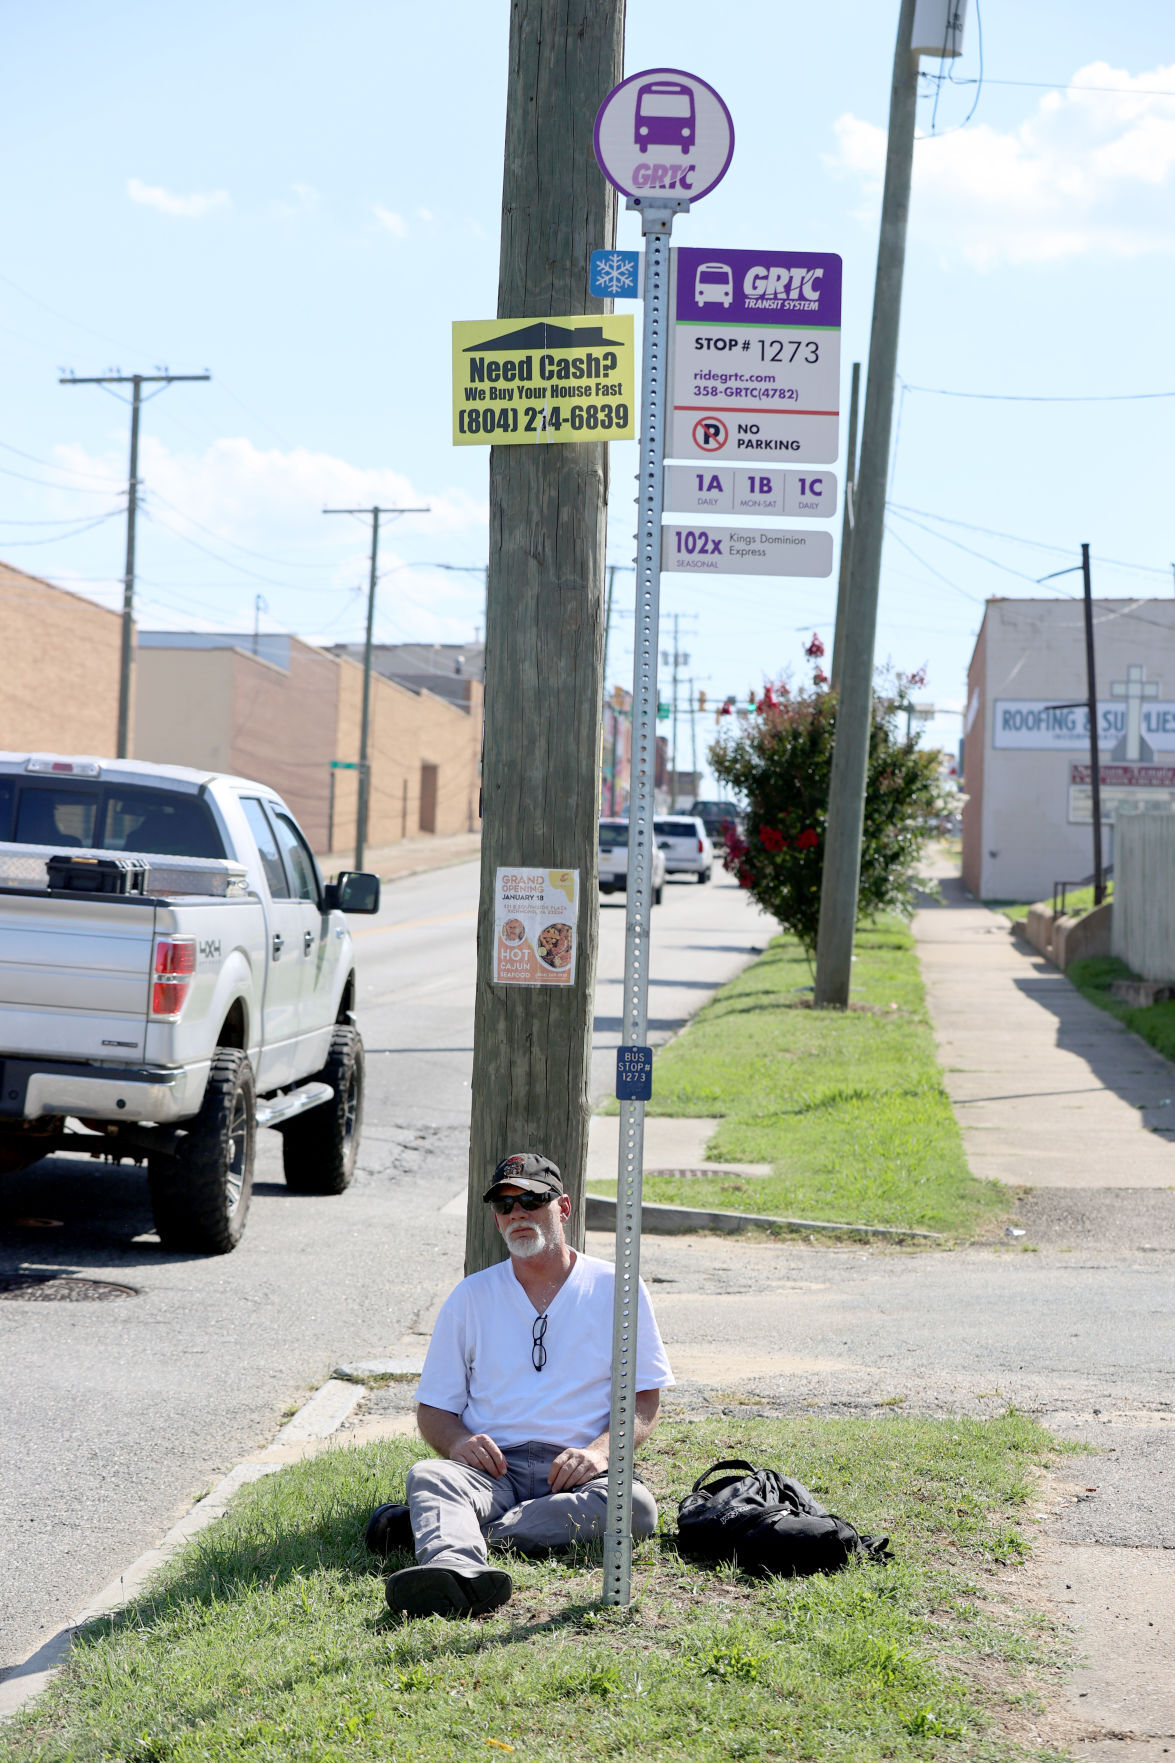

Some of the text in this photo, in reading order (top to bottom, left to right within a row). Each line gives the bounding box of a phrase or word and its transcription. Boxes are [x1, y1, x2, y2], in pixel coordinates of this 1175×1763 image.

[632, 163, 696, 190] GRTC
[743, 266, 824, 300] GRTC
[744, 299, 819, 311] TRANSIT SYSTEM
[694, 337, 738, 351] STOP
[758, 340, 819, 364] 1273
[469, 351, 618, 383] Need Cash?
[693, 370, 776, 384] ridegrtc.com
[464, 382, 623, 401] We Buy Your House Fast
[693, 385, 799, 402] 358-GRTC(4782)
[458, 403, 629, 434] (804) 214-6839
[737, 424, 760, 435] NO
[737, 439, 801, 451] PARKING
[696, 474, 724, 492] 1A
[747, 476, 773, 494] 1B
[798, 478, 823, 496] 1C
[697, 498, 719, 506] DAILY
[740, 500, 777, 508] MON-SAT
[798, 502, 820, 510] DAILY
[675, 531, 723, 555] 102x
[729, 532, 806, 545] Kings Dominion
[729, 546, 766, 558] Express
[676, 560, 718, 568] SEASONAL
[1002, 709, 1076, 732] ROOFING
[1102, 710, 1175, 733] SULIES
[502, 875, 545, 885] GRAND
[502, 885, 545, 893] OPENING
[501, 949, 530, 960] HOT
[500, 962, 530, 970] CAJUN
[624, 1052, 645, 1062] BUS
[622, 1073, 646, 1082] 1273
